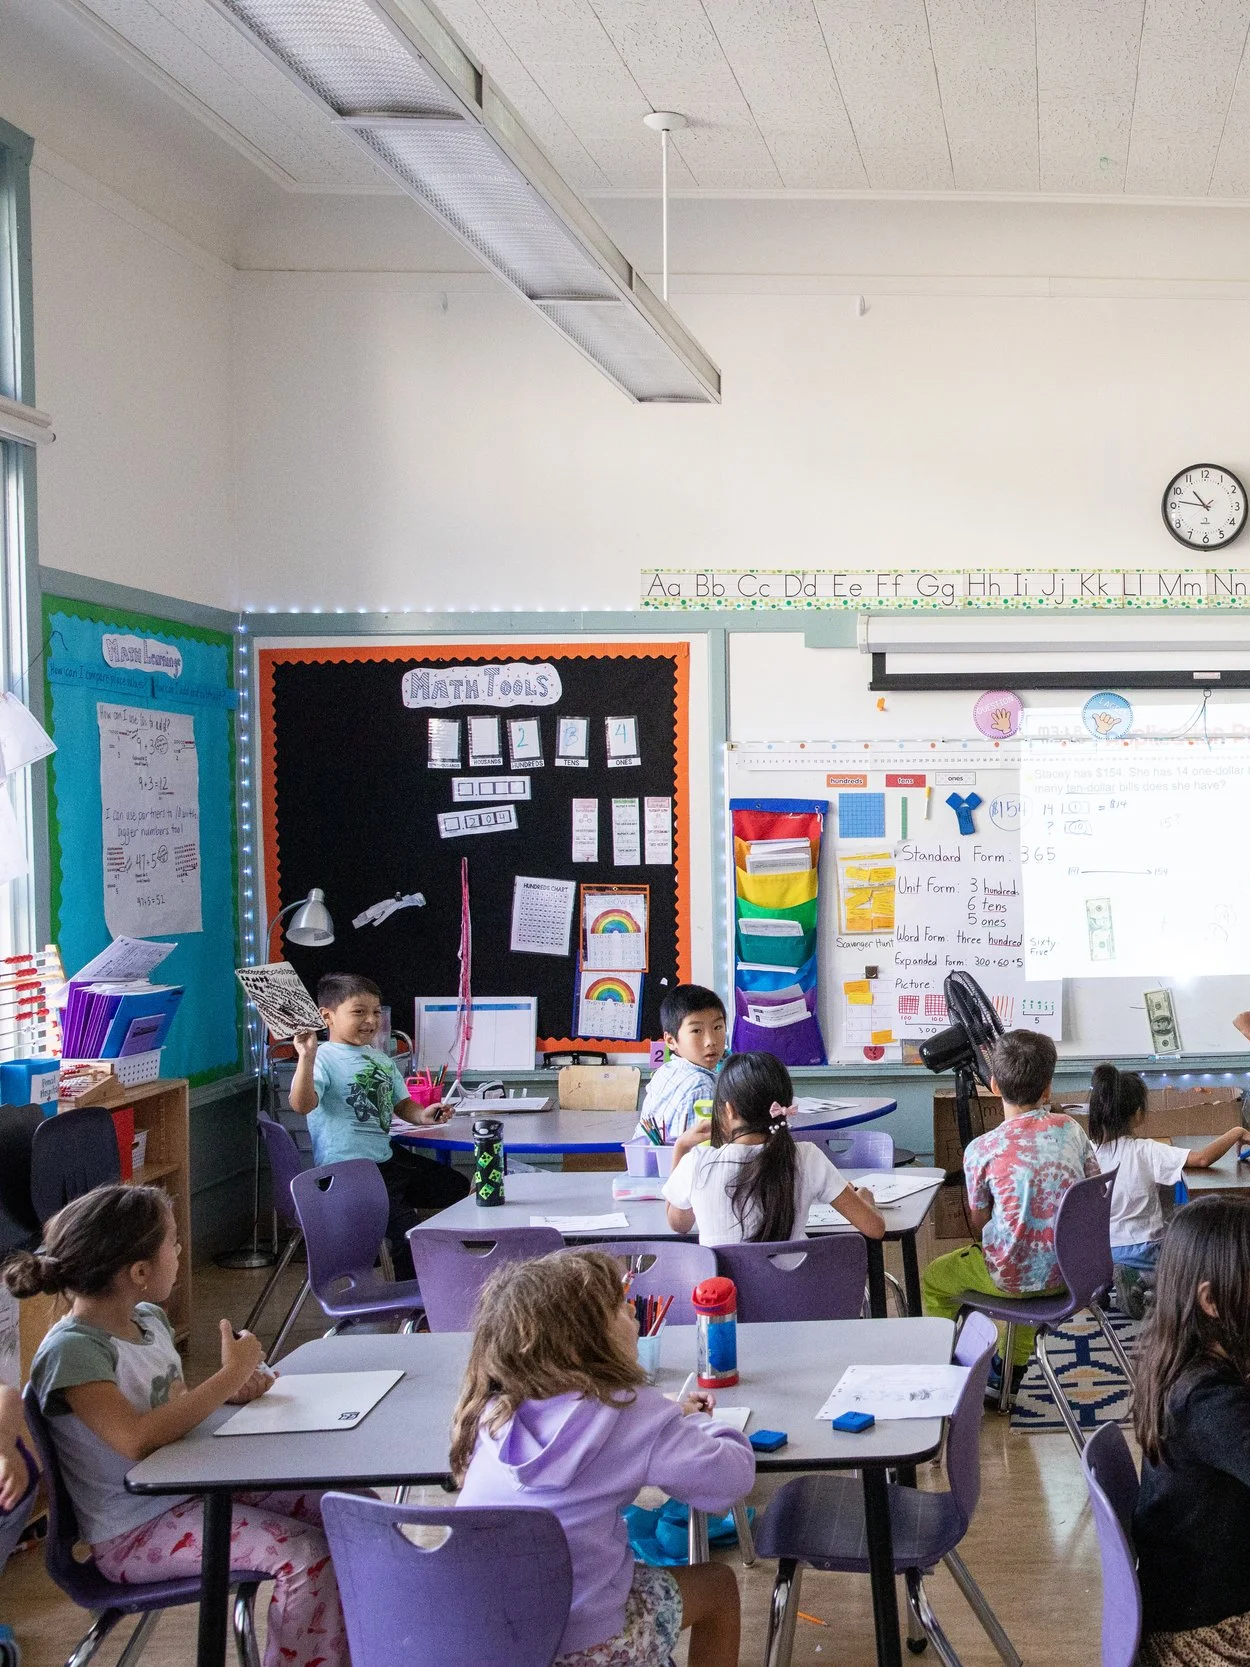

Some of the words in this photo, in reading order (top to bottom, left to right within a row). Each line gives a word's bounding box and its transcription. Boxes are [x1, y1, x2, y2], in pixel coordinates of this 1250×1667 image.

[1185, 474, 1192, 483] 11
[1201, 470, 1210, 478] 12
[1220, 475, 1223, 483] 1
[1173, 487, 1182, 495] 10
[1230, 485, 1237, 494] 2
[1234, 502, 1240, 511] 3
[1175, 519, 1181, 528] 8
[1229, 518, 1236, 526] 4
[1187, 531, 1193, 540] 7
[1202, 534, 1209, 544] 6
[1218, 530, 1225, 539] 5
[647, 573, 681, 597] Aa
[695, 573, 725, 597] Bb
[737, 573, 770, 597] Cc
[784, 573, 817, 597] Dd
[833, 573, 863, 597] Ee
[877, 573, 903, 597] Ff
[916, 573, 955, 606] Gg
[968, 573, 1001, 596] Hh
[1013, 573, 1028, 596] Ii
[1041, 573, 1064, 605] Jj
[1081, 573, 1108, 596] Kk
[1123, 573, 1142, 596] Ll
[1158, 573, 1201, 596] Mm
[1214, 573, 1246, 596] Nn
[410, 672, 480, 700] MATH
[484, 667, 549, 698] TOOLS
[516, 727, 529, 748] 2
[614, 723, 628, 744] 4
[563, 759, 580, 767] TENS
[615, 759, 633, 767] ONES
[1034, 769, 1071, 781] Stacey
[1074, 768, 1093, 778] has
[1129, 766, 1152, 777] She
[1153, 767, 1173, 777] has
[1176, 767, 1188, 776] 14
[1192, 765, 1245, 776] one-dollar
[830, 777, 863, 785] hundreds
[897, 777, 914, 785] tens
[1034, 784, 1063, 794] many
[1066, 782, 1116, 793] ten-dollar
[1119, 782, 1140, 791] bills
[1142, 781, 1168, 791] does
[1171, 781, 1191, 790] she
[1194, 779, 1226, 790] have?
[902, 845, 961, 862] Standard
[973, 845, 1012, 862] Form:
[1020, 845, 1057, 863] 365
[523, 883, 550, 891] HUNDREDS
[551, 884, 568, 893] CHART
[897, 876, 922, 894] Unit
[927, 876, 961, 894] Form:
[970, 877, 978, 893] 3
[967, 896, 976, 911] 6
[982, 898, 1007, 912] tens
[968, 912, 978, 926] 5
[981, 918, 1007, 928] ones
[897, 925, 920, 942] Word
[925, 926, 949, 942] Form:
[957, 930, 982, 944] three
[989, 931, 1023, 947] hundred
[875, 938, 894, 949] Hunt
[895, 952, 937, 969] Expanded
[945, 953, 968, 966] Form:
[895, 977, 935, 990] Picture:
[654, 1050, 664, 1062] 2
